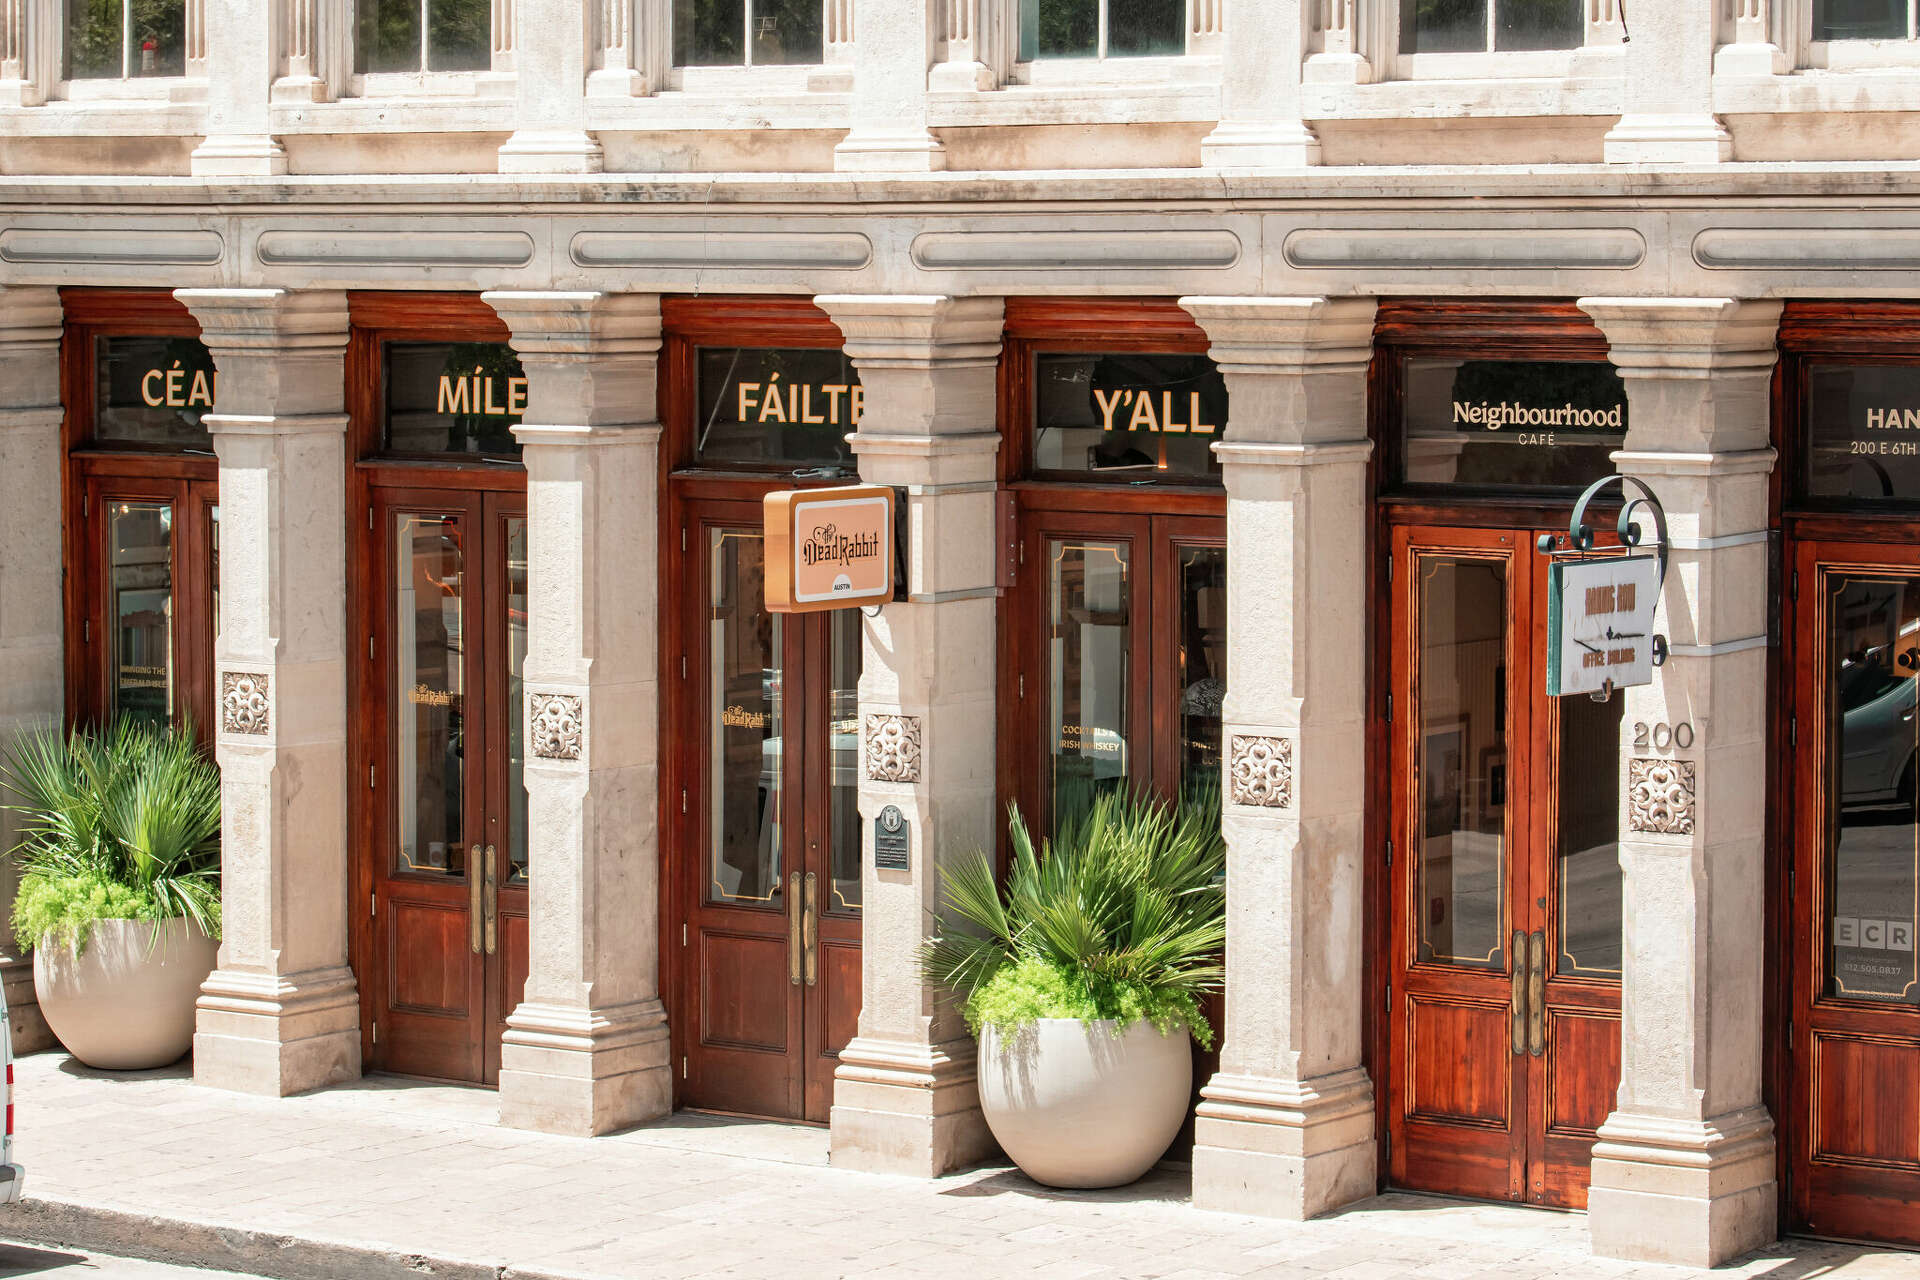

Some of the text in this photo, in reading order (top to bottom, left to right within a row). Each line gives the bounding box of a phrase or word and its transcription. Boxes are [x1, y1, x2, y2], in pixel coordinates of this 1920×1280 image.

[141, 359, 217, 407] CÉA
[437, 365, 529, 416] MÍLE
[1452, 400, 1623, 431] Neighbourhood
[1518, 432, 1556, 446] CAFÉ
[1850, 441, 1916, 456] 200 E 6TH
[803, 531, 879, 567] Dead Rabbit
[833, 583, 851, 592] AUSTIN
[152, 666, 166, 675] THE
[1633, 722, 1694, 749] 200
[1839, 924, 1907, 945] ECR
